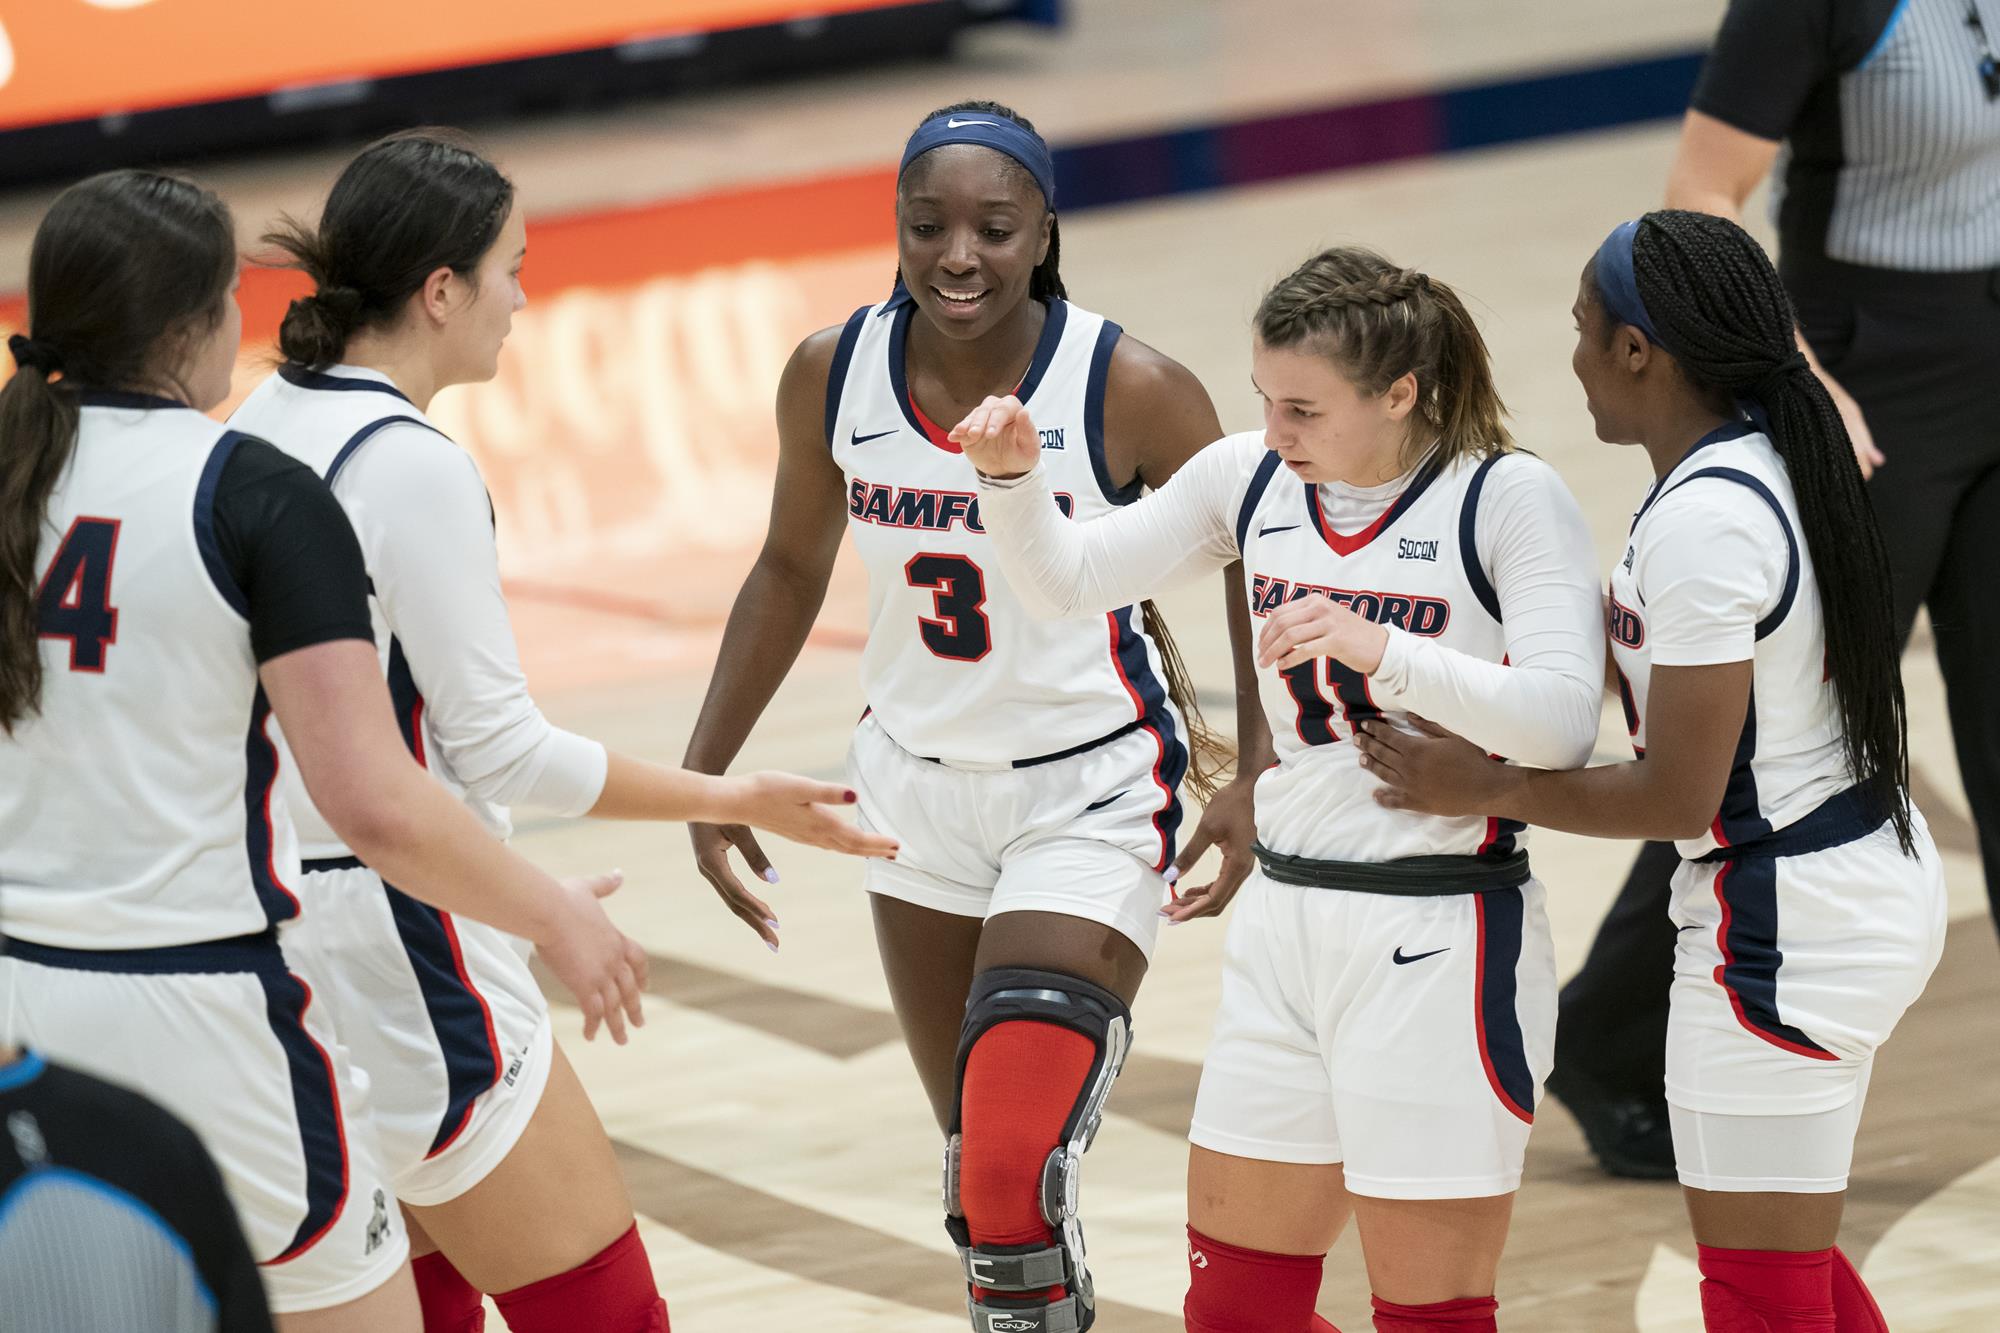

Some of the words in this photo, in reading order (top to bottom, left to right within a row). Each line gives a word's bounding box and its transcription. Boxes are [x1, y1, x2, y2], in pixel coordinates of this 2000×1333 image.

[1039, 428, 1065, 450] CON
[1398, 538, 1439, 562] SOCON
[33, 515, 122, 674] 4
[904, 552, 992, 663] 3
[994, 1320, 1040, 1332] DONJOY
